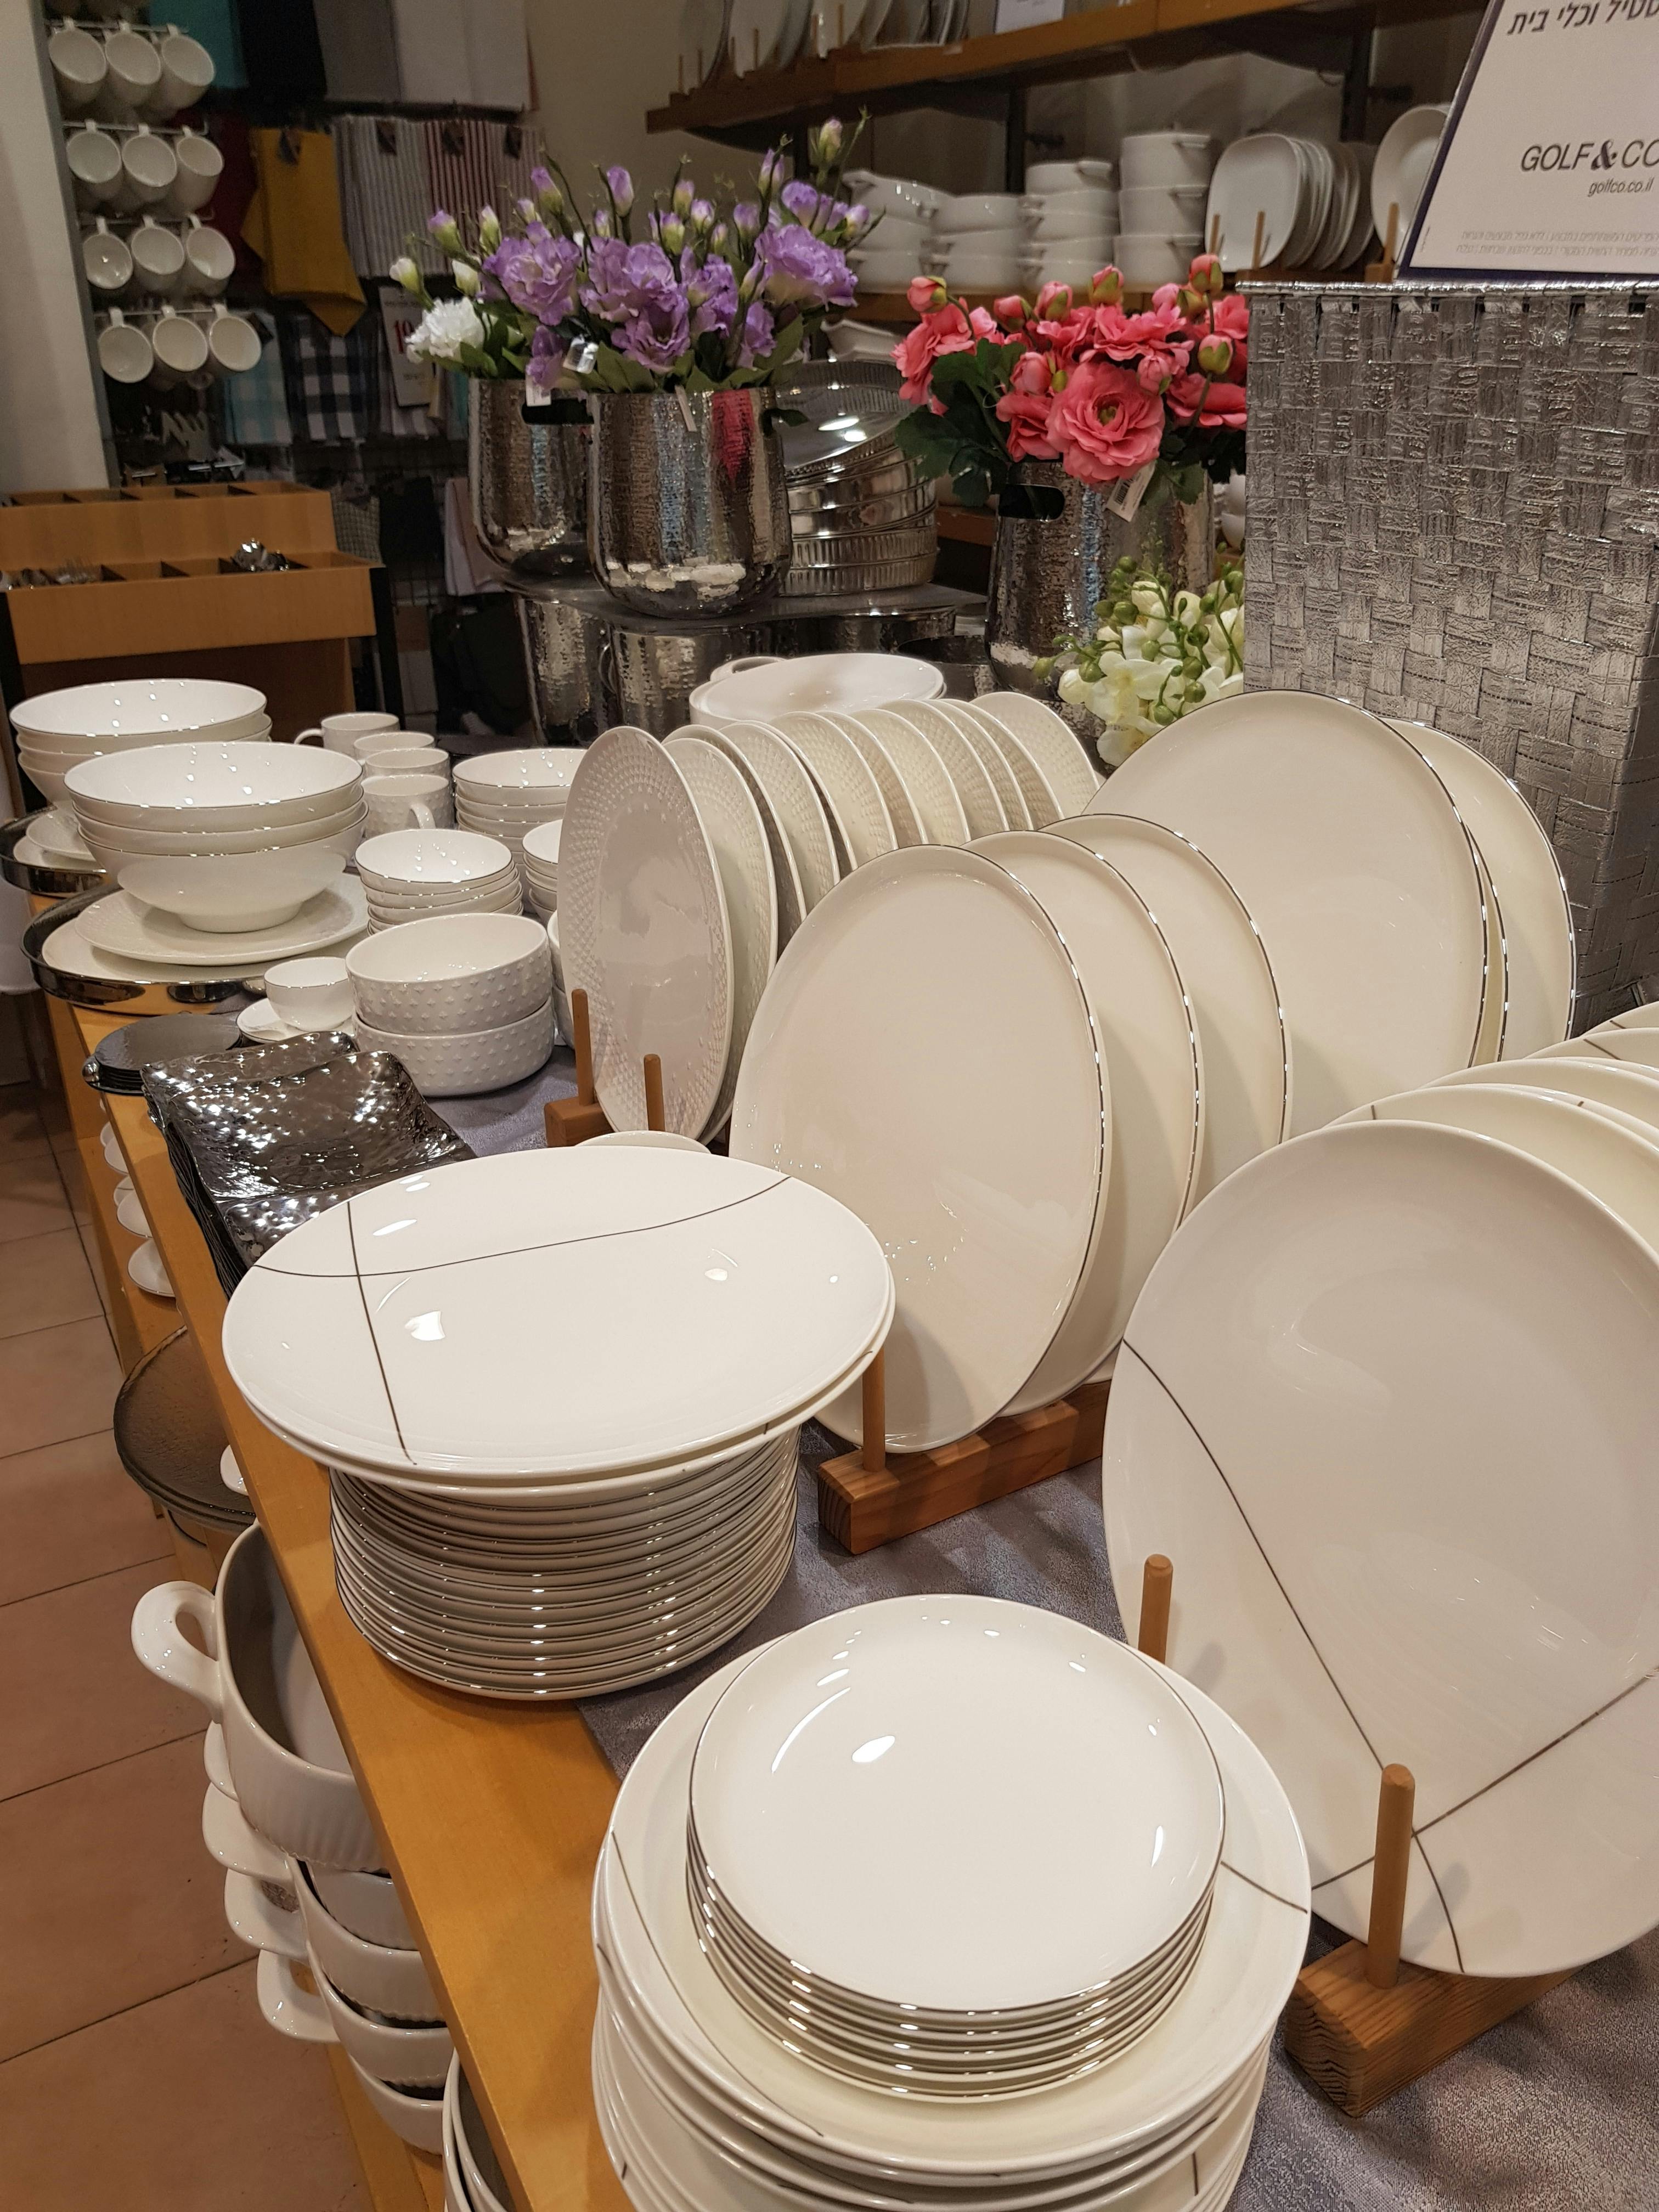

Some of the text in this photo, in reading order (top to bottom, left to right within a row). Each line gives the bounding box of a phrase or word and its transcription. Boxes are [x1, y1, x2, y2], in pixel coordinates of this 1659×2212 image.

[1506, 8, 1550, 36] בית
[1556, 1, 1601, 30] וכלי
[1587, 176, 1655, 198] golfco.co.il
